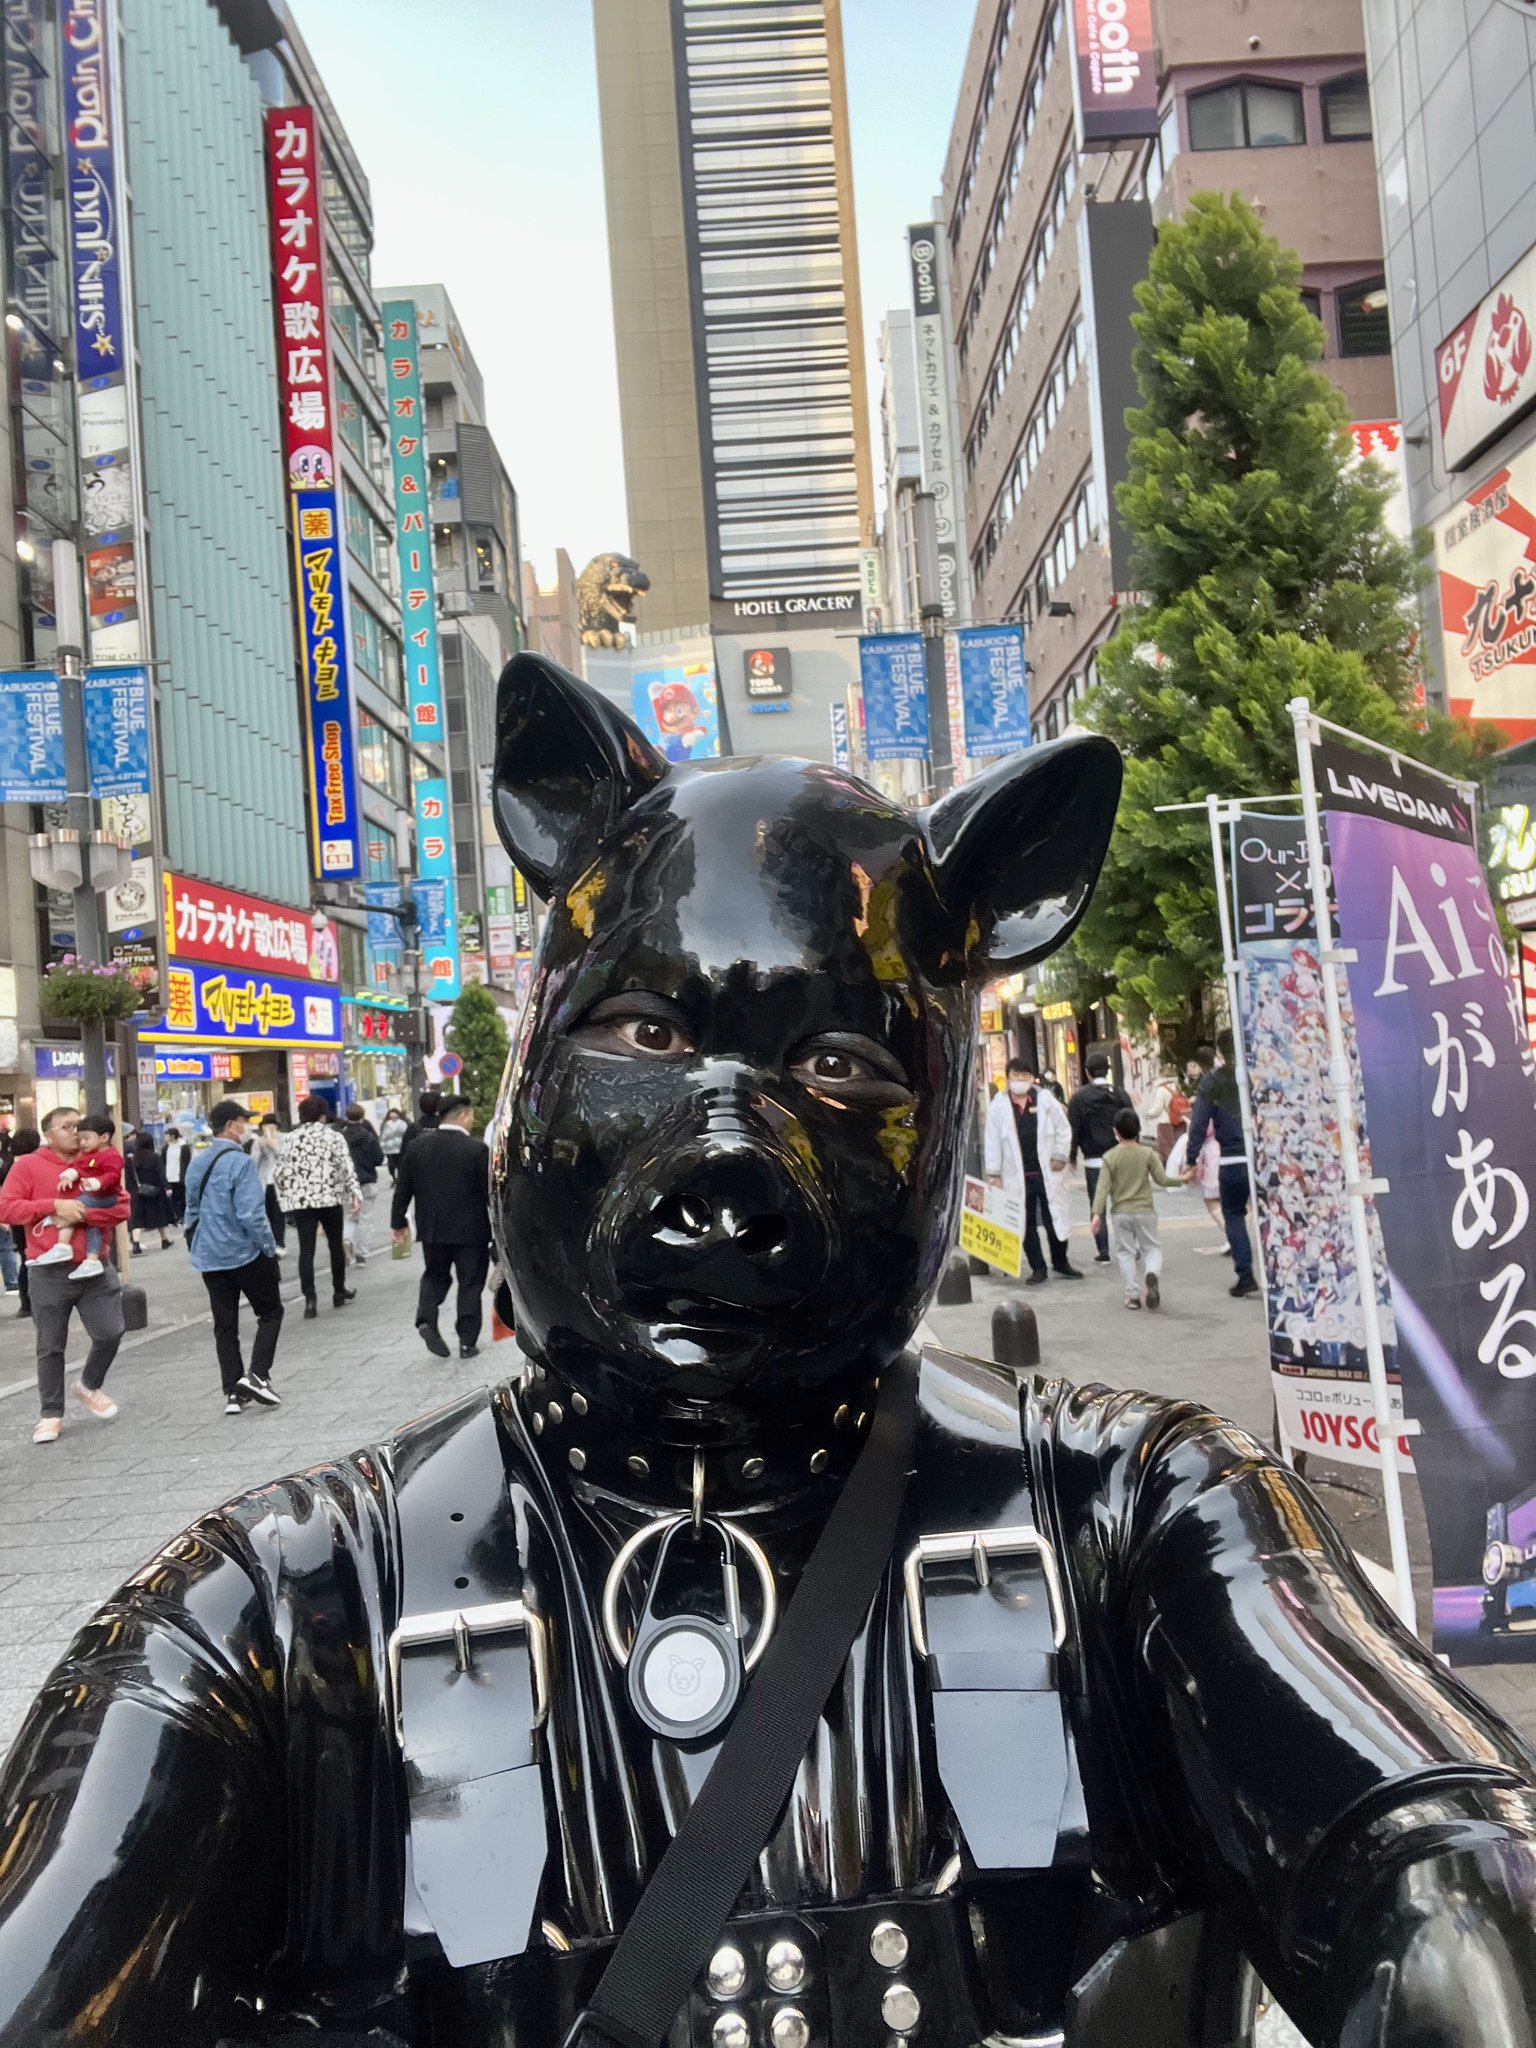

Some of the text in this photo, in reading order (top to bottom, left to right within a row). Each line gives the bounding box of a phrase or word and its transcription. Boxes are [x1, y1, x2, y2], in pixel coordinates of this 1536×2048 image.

[73, 178, 113, 330] SHINJUKU
[275, 120, 326, 430] カラオケ歌広場
[1440, 330, 1466, 384] 6F
[303, 511, 329, 536] 薬
[390, 319, 438, 724] カラオケ&パーティー館
[304, 547, 338, 701] マツモトキヨシ
[734, 595, 854, 616] HOTEL GRACERY
[890, 653, 925, 731] BLUE FESTIVAL
[990, 646, 1021, 728] BLUE FESTIVAL
[26, 692, 62, 774] BLUE FESTIVAL
[112, 687, 145, 768] BLUE FESTIVAL
[323, 721, 341, 760] Shop
[326, 761, 343, 796] Free
[328, 797, 345, 824] Tax
[176, 892, 308, 965] カラオケ歌広場
[168, 975, 193, 1023] 薬
[202, 976, 294, 1034] マツモトキヨシ
